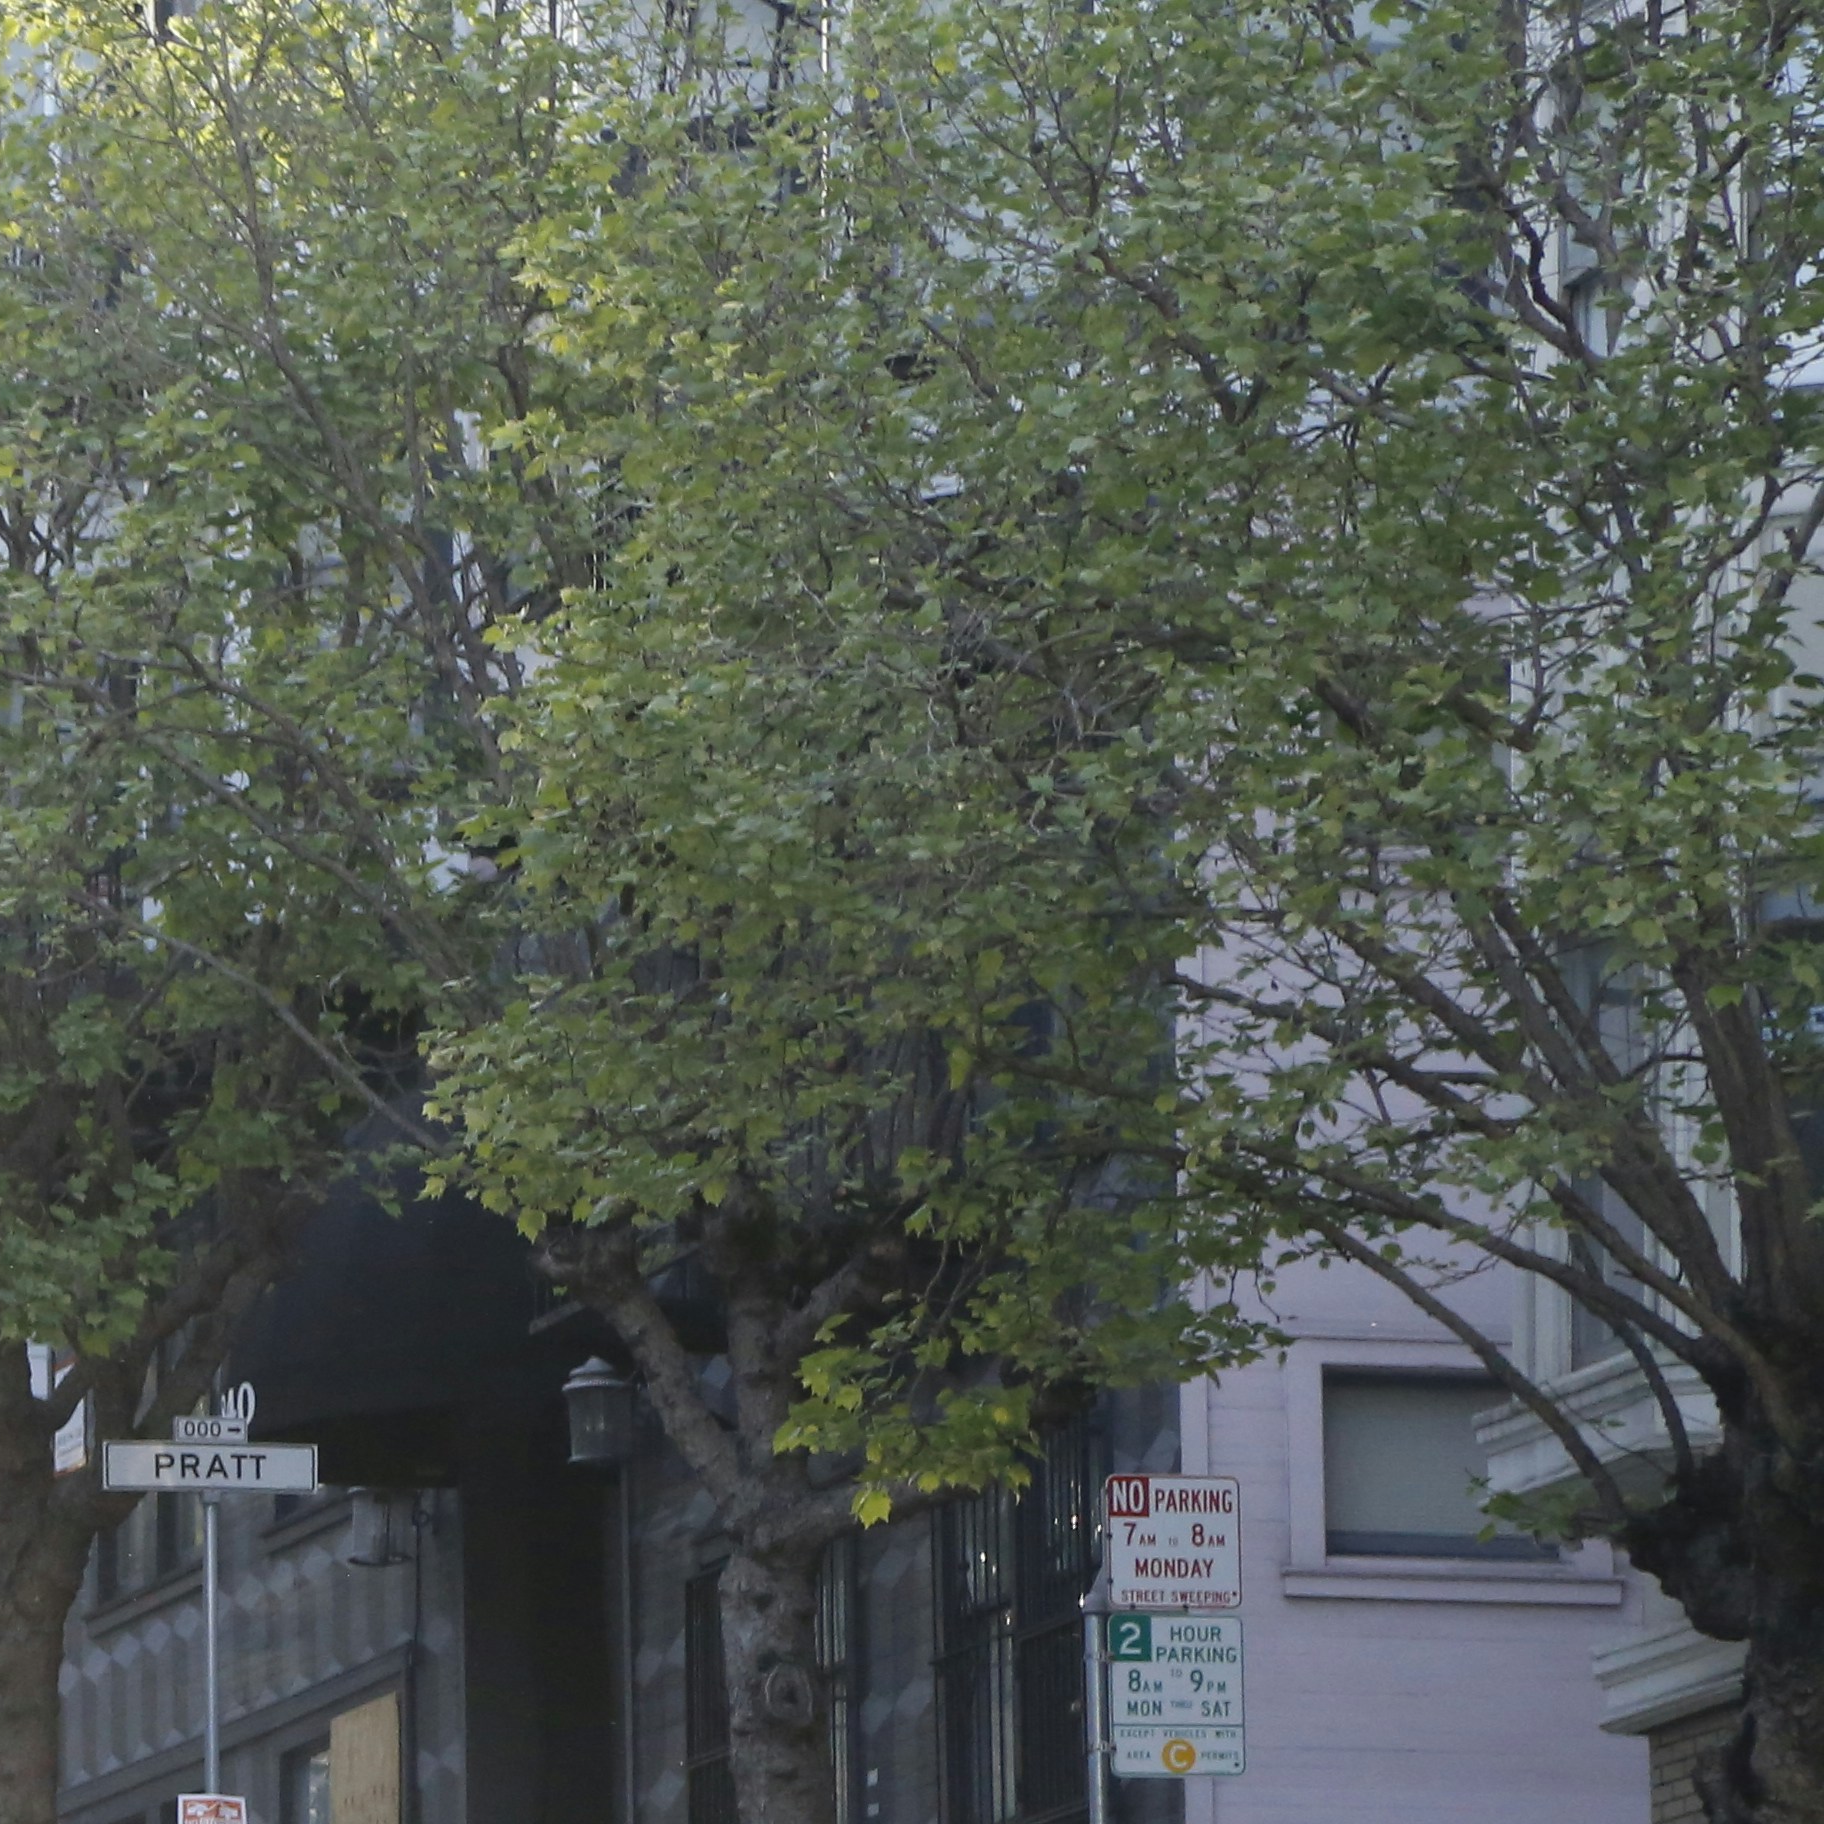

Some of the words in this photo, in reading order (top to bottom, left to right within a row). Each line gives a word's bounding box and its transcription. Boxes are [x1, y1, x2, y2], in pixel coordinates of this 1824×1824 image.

[184, 1420, 221, 1437] 000
[154, 1453, 267, 1480] PRATT
[1112, 1480, 1145, 1513] NO
[1155, 1489, 1233, 1514] PARKING
[1135, 1558, 1215, 1579] MONDAY
[1121, 1589, 1164, 1602] STREET
[1120, 1622, 1142, 1655] 2
[1170, 1626, 1221, 1643] HOUR
[1156, 1647, 1237, 1664] PARKING
[1127, 1701, 1162, 1717] MON
[1202, 1702, 1231, 1717] SAT
[1120, 1730, 1155, 1740] EXCEPT
[1163, 1730, 1207, 1740] VEHICLES
[1126, 1750, 1151, 1761] AREA
[1168, 1745, 1188, 1767] C
